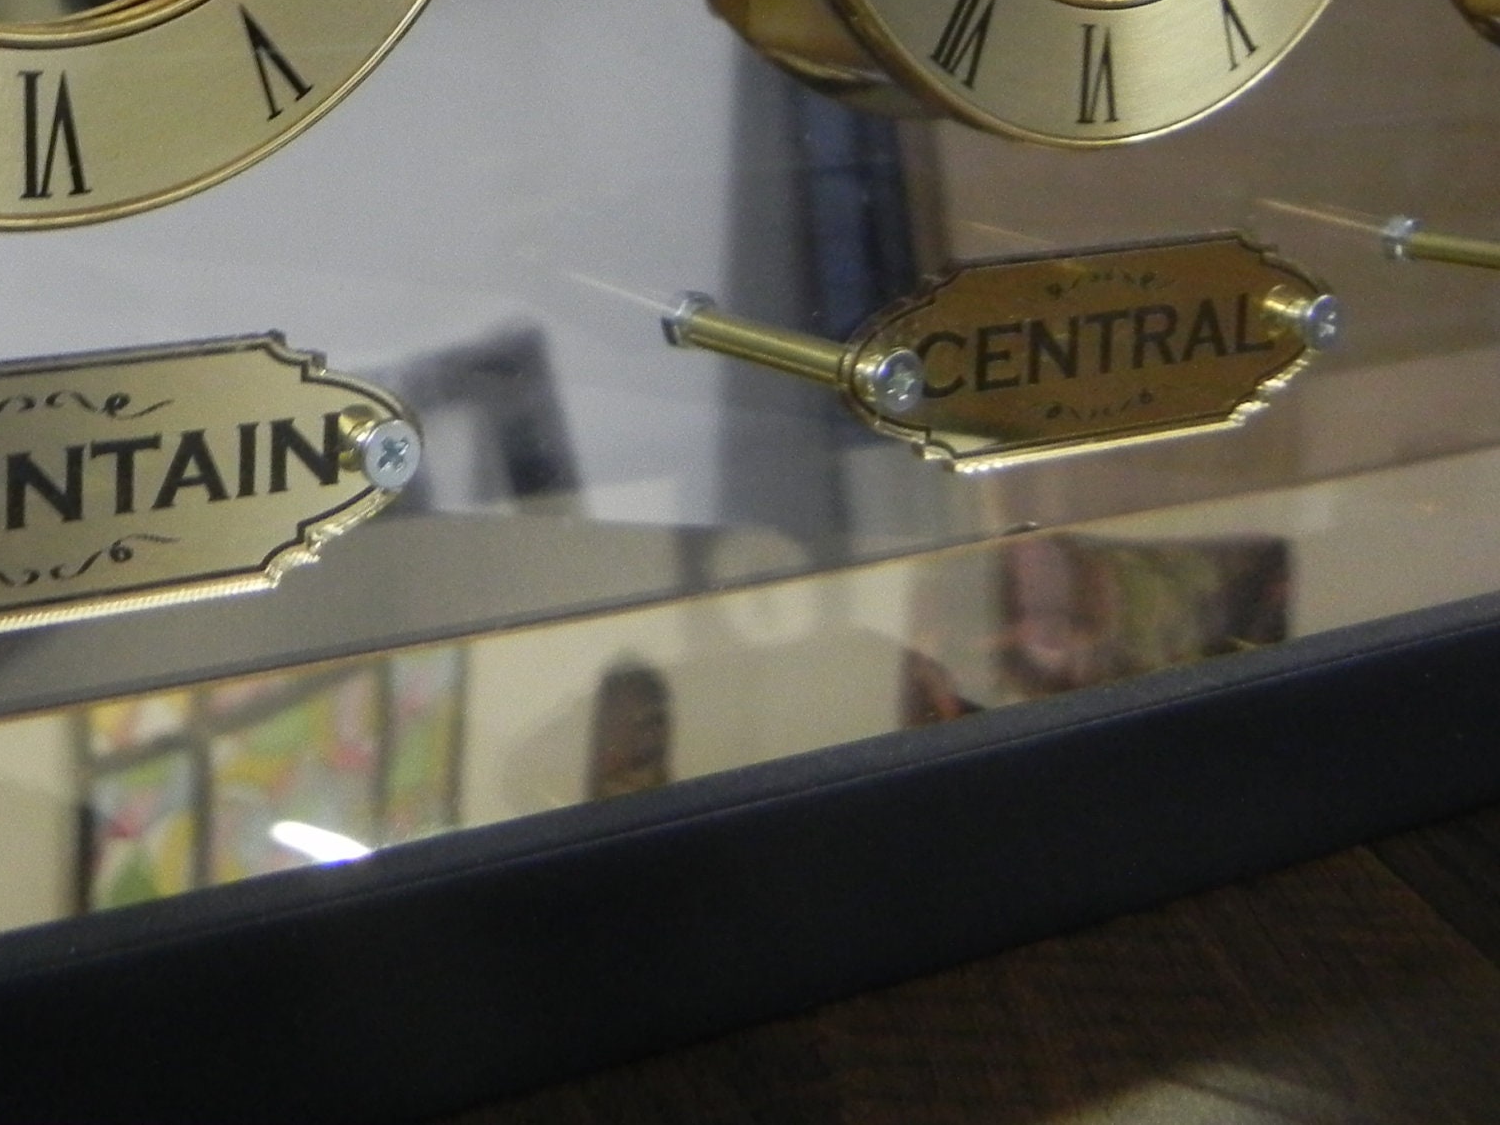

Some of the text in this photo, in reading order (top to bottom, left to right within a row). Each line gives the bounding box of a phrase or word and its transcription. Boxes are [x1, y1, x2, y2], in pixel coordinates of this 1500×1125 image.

[240, 3, 312, 122] V
[1076, 23, 1118, 125] VI
[18, 69, 92, 199] VI
[917, 291, 1276, 400] CENTRAL
